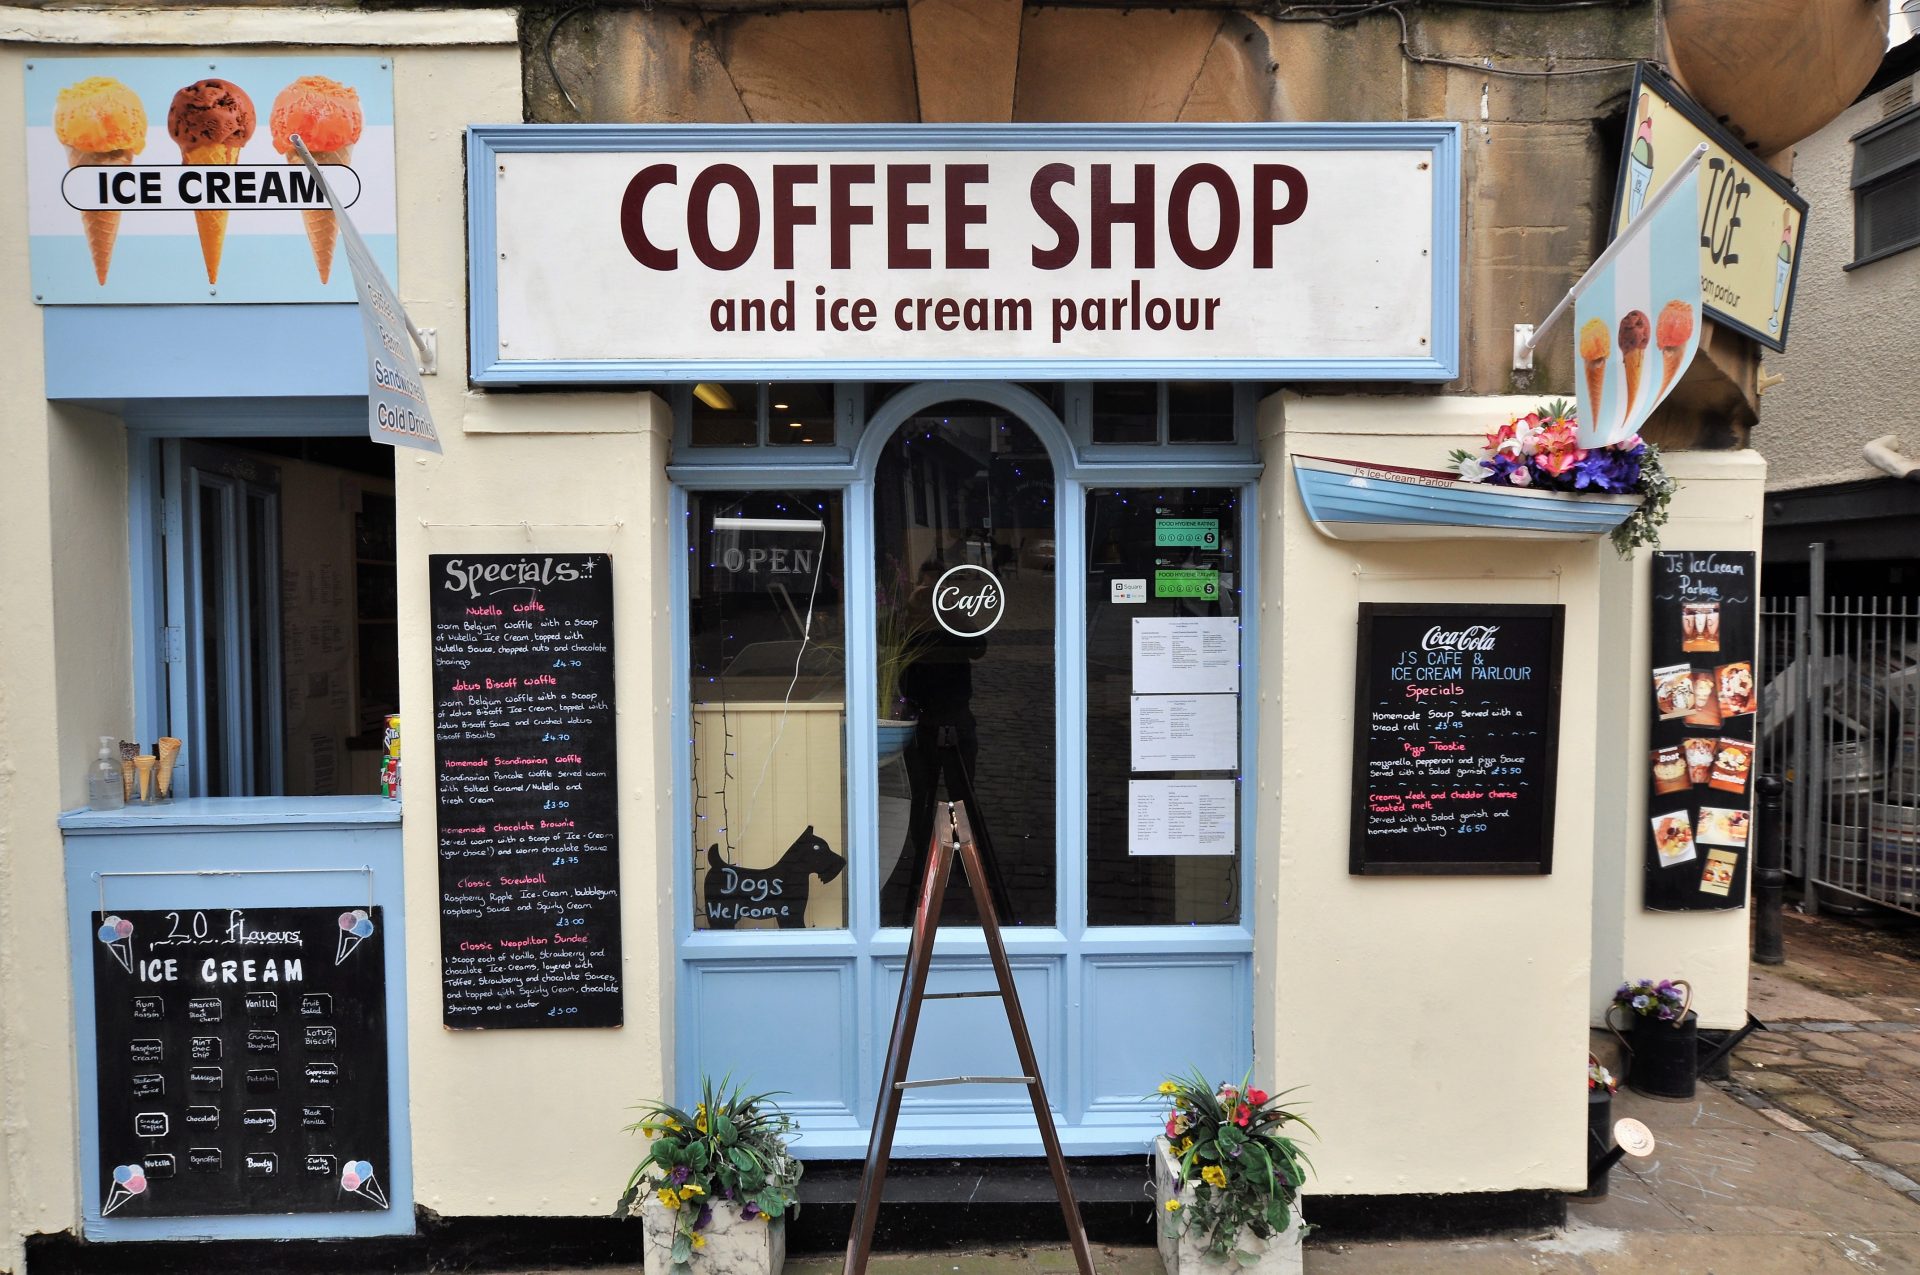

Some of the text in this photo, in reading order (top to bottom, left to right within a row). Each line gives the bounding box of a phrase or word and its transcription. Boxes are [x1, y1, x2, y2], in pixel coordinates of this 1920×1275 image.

[99, 171, 325, 204] ICE CREAM
[619, 161, 1309, 272] COFFEE SHOP
[1701, 158, 1751, 268] ICE
[709, 281, 1221, 343] and ice cream parlour
[378, 403, 405, 430] Cold
[1368, 470, 1416, 484] Ice-Cream
[1419, 477, 1454, 488] Parlour
[724, 548, 812, 573] OPEN
[937, 585, 997, 617] Café
[466, 605, 502, 615] Nutella
[464, 621, 496, 634] Belgium
[504, 621, 532, 629] waffle
[449, 633, 477, 641] Nutella
[535, 633, 561, 641] topped
[565, 631, 584, 640] with
[1422, 626, 1500, 650] Coca-Cola
[435, 645, 463, 653] Nutella
[498, 645, 528, 654] chopped
[1428, 652, 1462, 665] CAFE
[1474, 652, 1483, 665] &
[1392, 667, 1531, 680] ICE CREAM PARLOUR
[452, 679, 480, 691] Lotus
[486, 678, 517, 689] Biscoff
[1406, 683, 1464, 701] Specials
[469, 696, 501, 709] Belgium
[560, 703, 584, 712] topped
[589, 701, 608, 710] with
[1372, 708, 1511, 723] Homemade Soup with
[437, 732, 460, 740] Biscoff
[1429, 741, 1466, 751] Toastie
[445, 758, 488, 768] Homemade
[1416, 755, 1454, 768] pepperoni
[1660, 753, 1679, 762] Boat
[1370, 794, 1401, 804] Creamy
[1370, 803, 1405, 812] Toasted
[541, 818, 574, 828] Brownie
[1413, 823, 1446, 836] chutney
[498, 835, 516, 844] with
[458, 873, 546, 887] Classic Screwball
[721, 868, 783, 901] Dogs
[444, 893, 513, 906] Raspberry Ripple
[708, 902, 789, 919] Welcome
[460, 942, 493, 950] Classic
[140, 958, 303, 983] ICE CREAM
[543, 962, 571, 971] layered
[575, 960, 593, 968] with
[466, 990, 493, 999] topped
[497, 988, 514, 996] with
[246, 996, 276, 1007] Vanilla
[246, 1158, 272, 1172] Bounty
